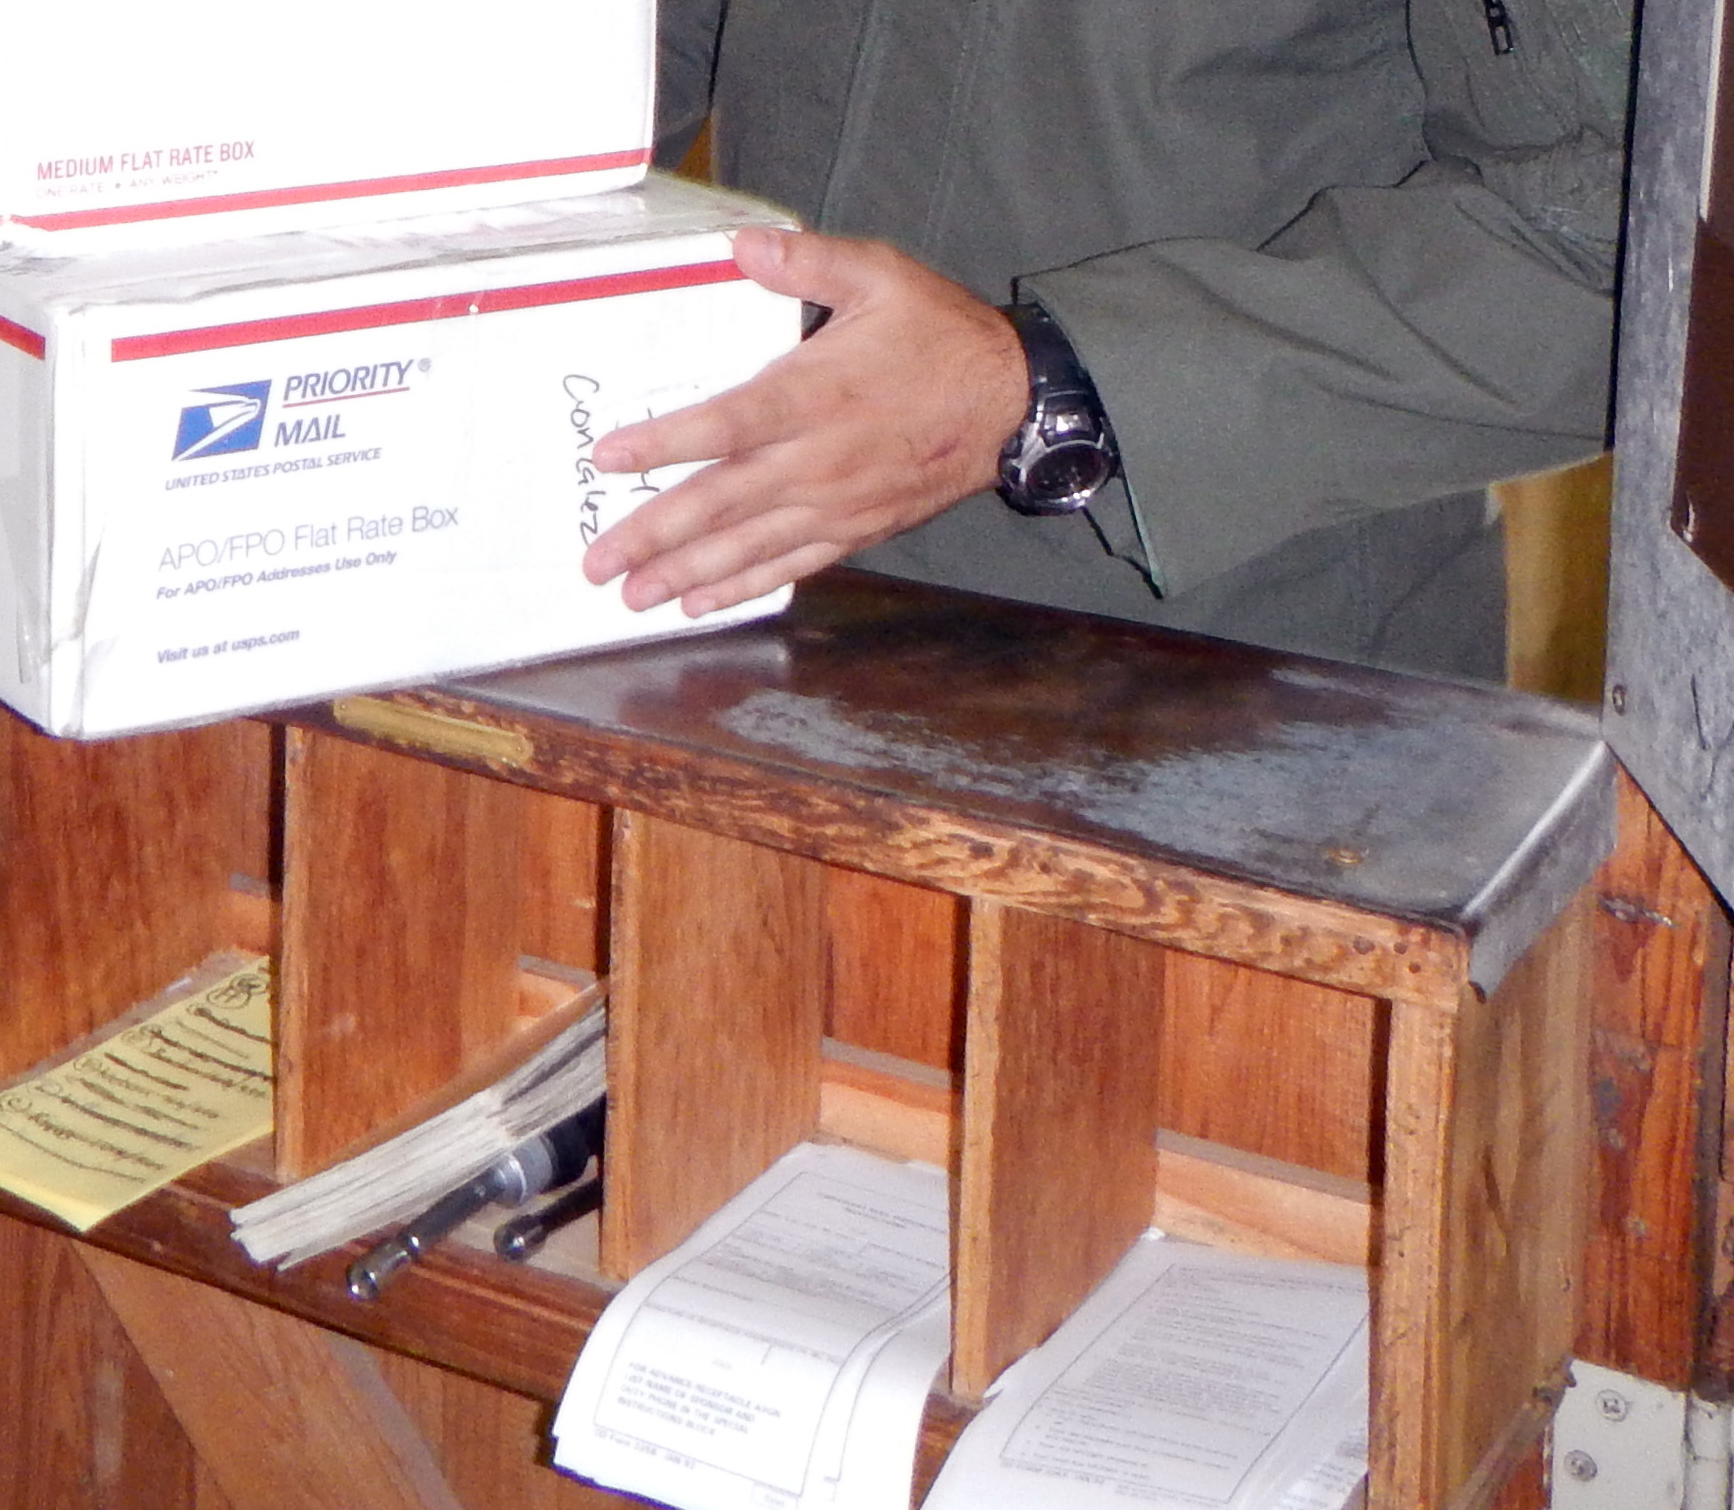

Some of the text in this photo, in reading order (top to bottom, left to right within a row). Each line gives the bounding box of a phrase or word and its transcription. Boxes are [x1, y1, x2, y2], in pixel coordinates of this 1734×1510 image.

[37, 140, 256, 182] MEDIUM FLAT RATE BOX
[283, 358, 415, 401] PRIORITY
[274, 414, 346, 448] MAIL
[165, 447, 383, 491] UNITED STATES POSTAL SERVICE
[158, 504, 459, 573] APO/FPO Flat Rate Box
[156, 549, 398, 600] For APO/FPO Addresses Use Only
[157, 628, 301, 664] Visit us at usps.com
